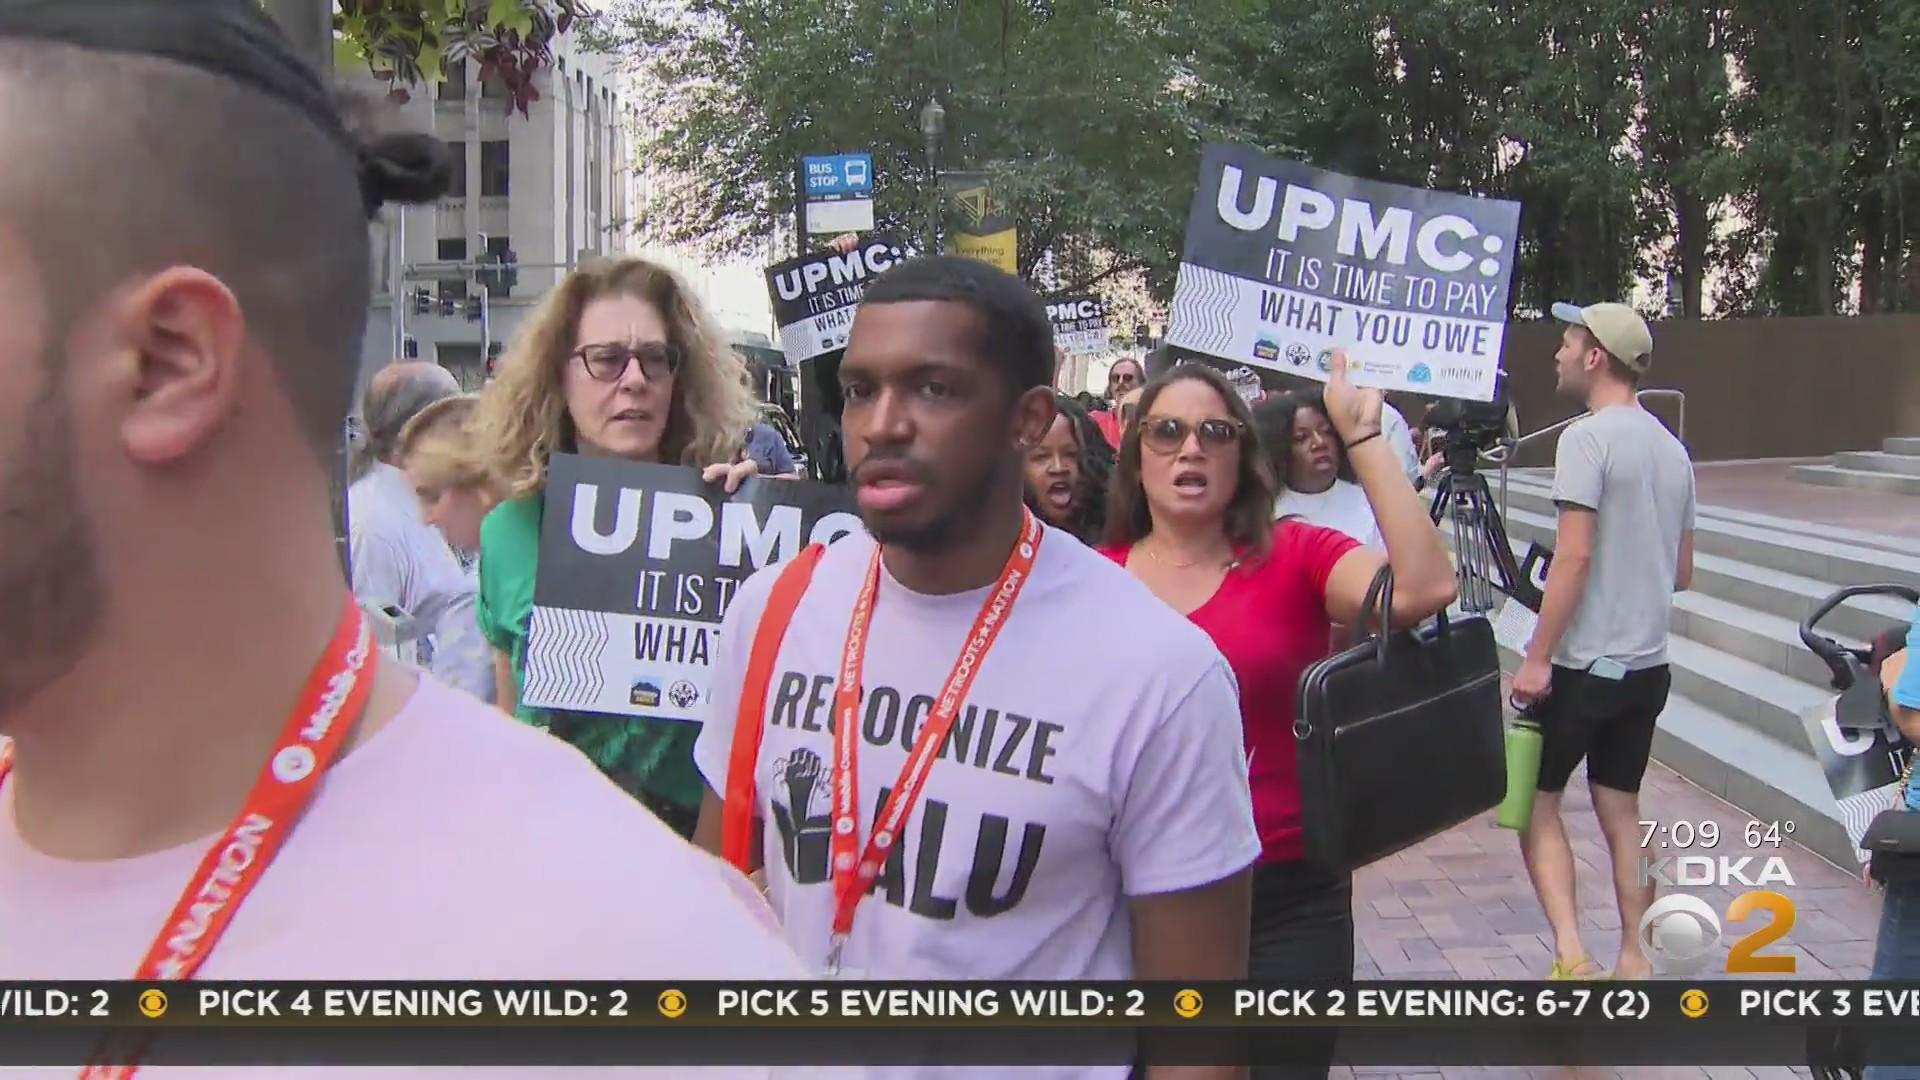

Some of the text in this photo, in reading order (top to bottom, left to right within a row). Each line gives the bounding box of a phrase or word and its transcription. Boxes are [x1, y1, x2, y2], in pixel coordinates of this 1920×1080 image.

[808, 163, 833, 175] BUS
[809, 176, 839, 188] STOP
[1216, 164, 1503, 278] UPMC:
[775, 243, 903, 301] UPMC:
[1265, 248, 1497, 316] IT IS TIME TO PAY
[808, 298, 821, 314] IT
[822, 291, 836, 311] IS
[815, 308, 851, 332] WHAT
[1045, 300, 1101, 321] PMC:
[1260, 288, 1490, 356] WHAT YOU OWE
[636, 570, 666, 611] IT
[675, 573, 704, 615] IS
[936, 568, 1023, 718] NETROOTS NATION
[771, 671, 1065, 785] REOGNIZE
[168, 812, 273, 954] NATION
